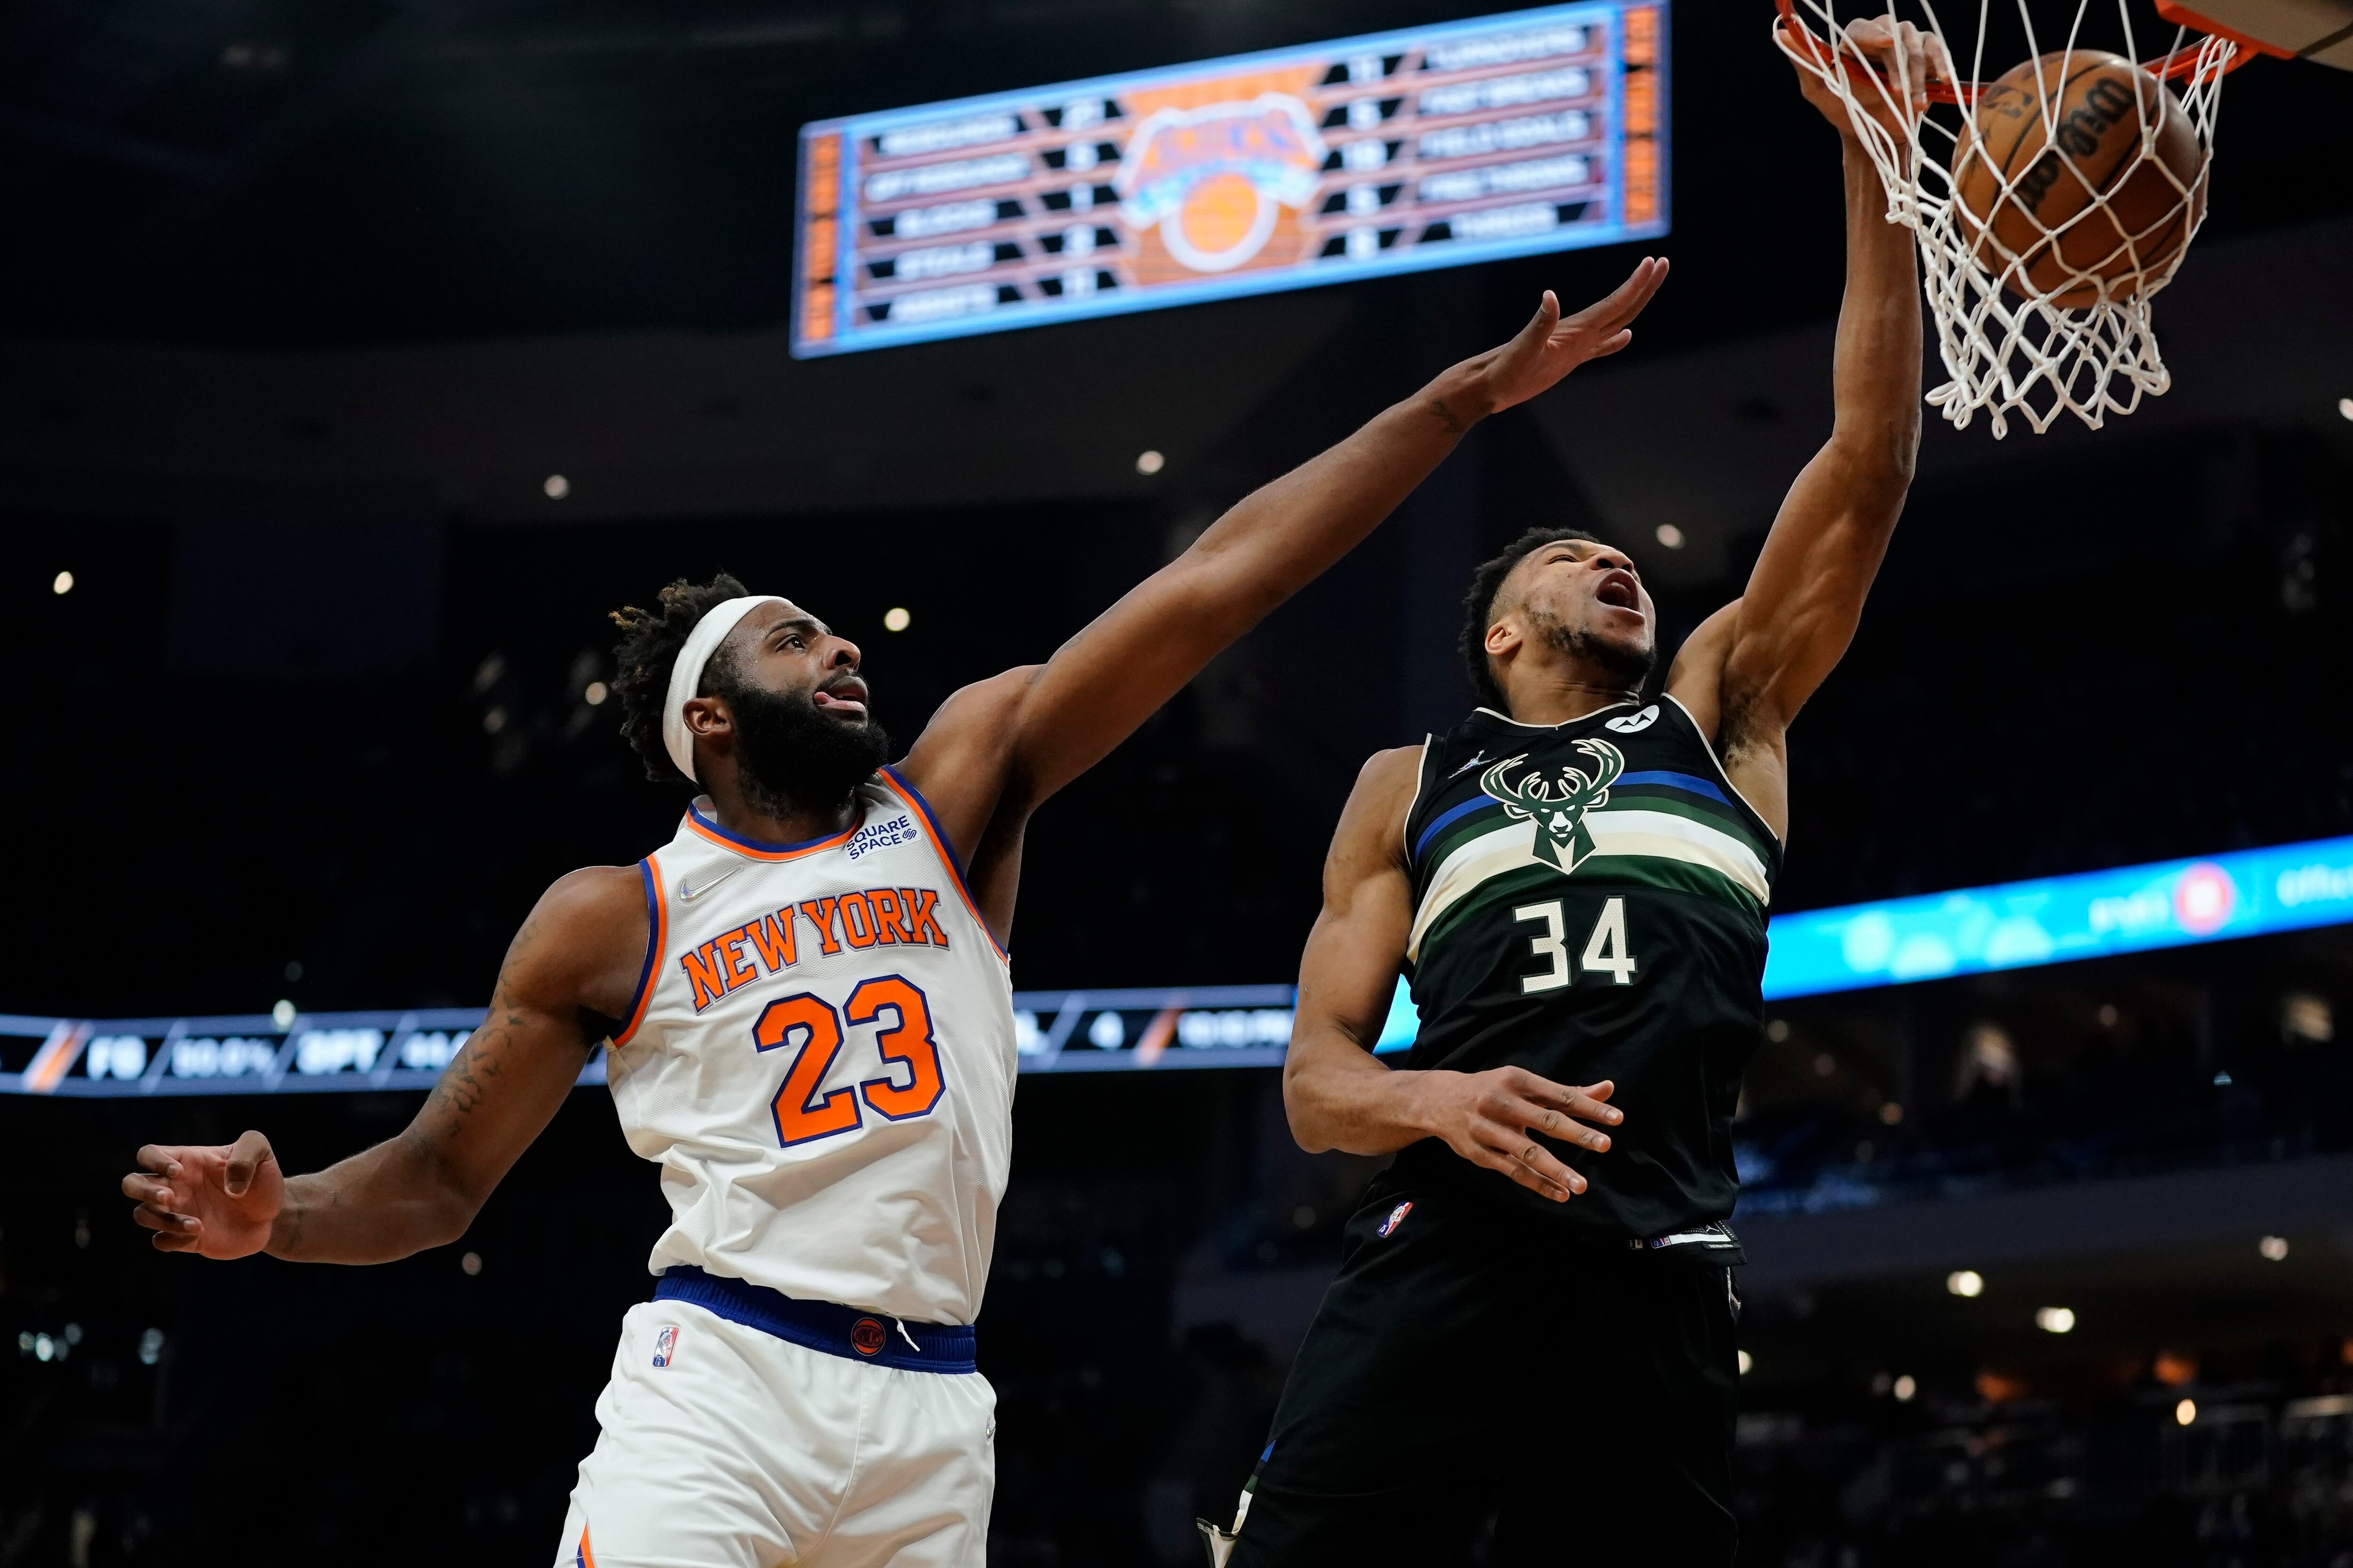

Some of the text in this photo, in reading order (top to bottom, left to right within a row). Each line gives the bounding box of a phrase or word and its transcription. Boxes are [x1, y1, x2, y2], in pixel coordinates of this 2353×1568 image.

[847, 815, 910, 850] SQUARE
[849, 833, 902, 860] SPACE
[679, 887, 950, 1016] NEW YORK
[1512, 895, 1638, 995] 34
[752, 973, 946, 1148] 23
[655, 1355, 662, 1365] 75
